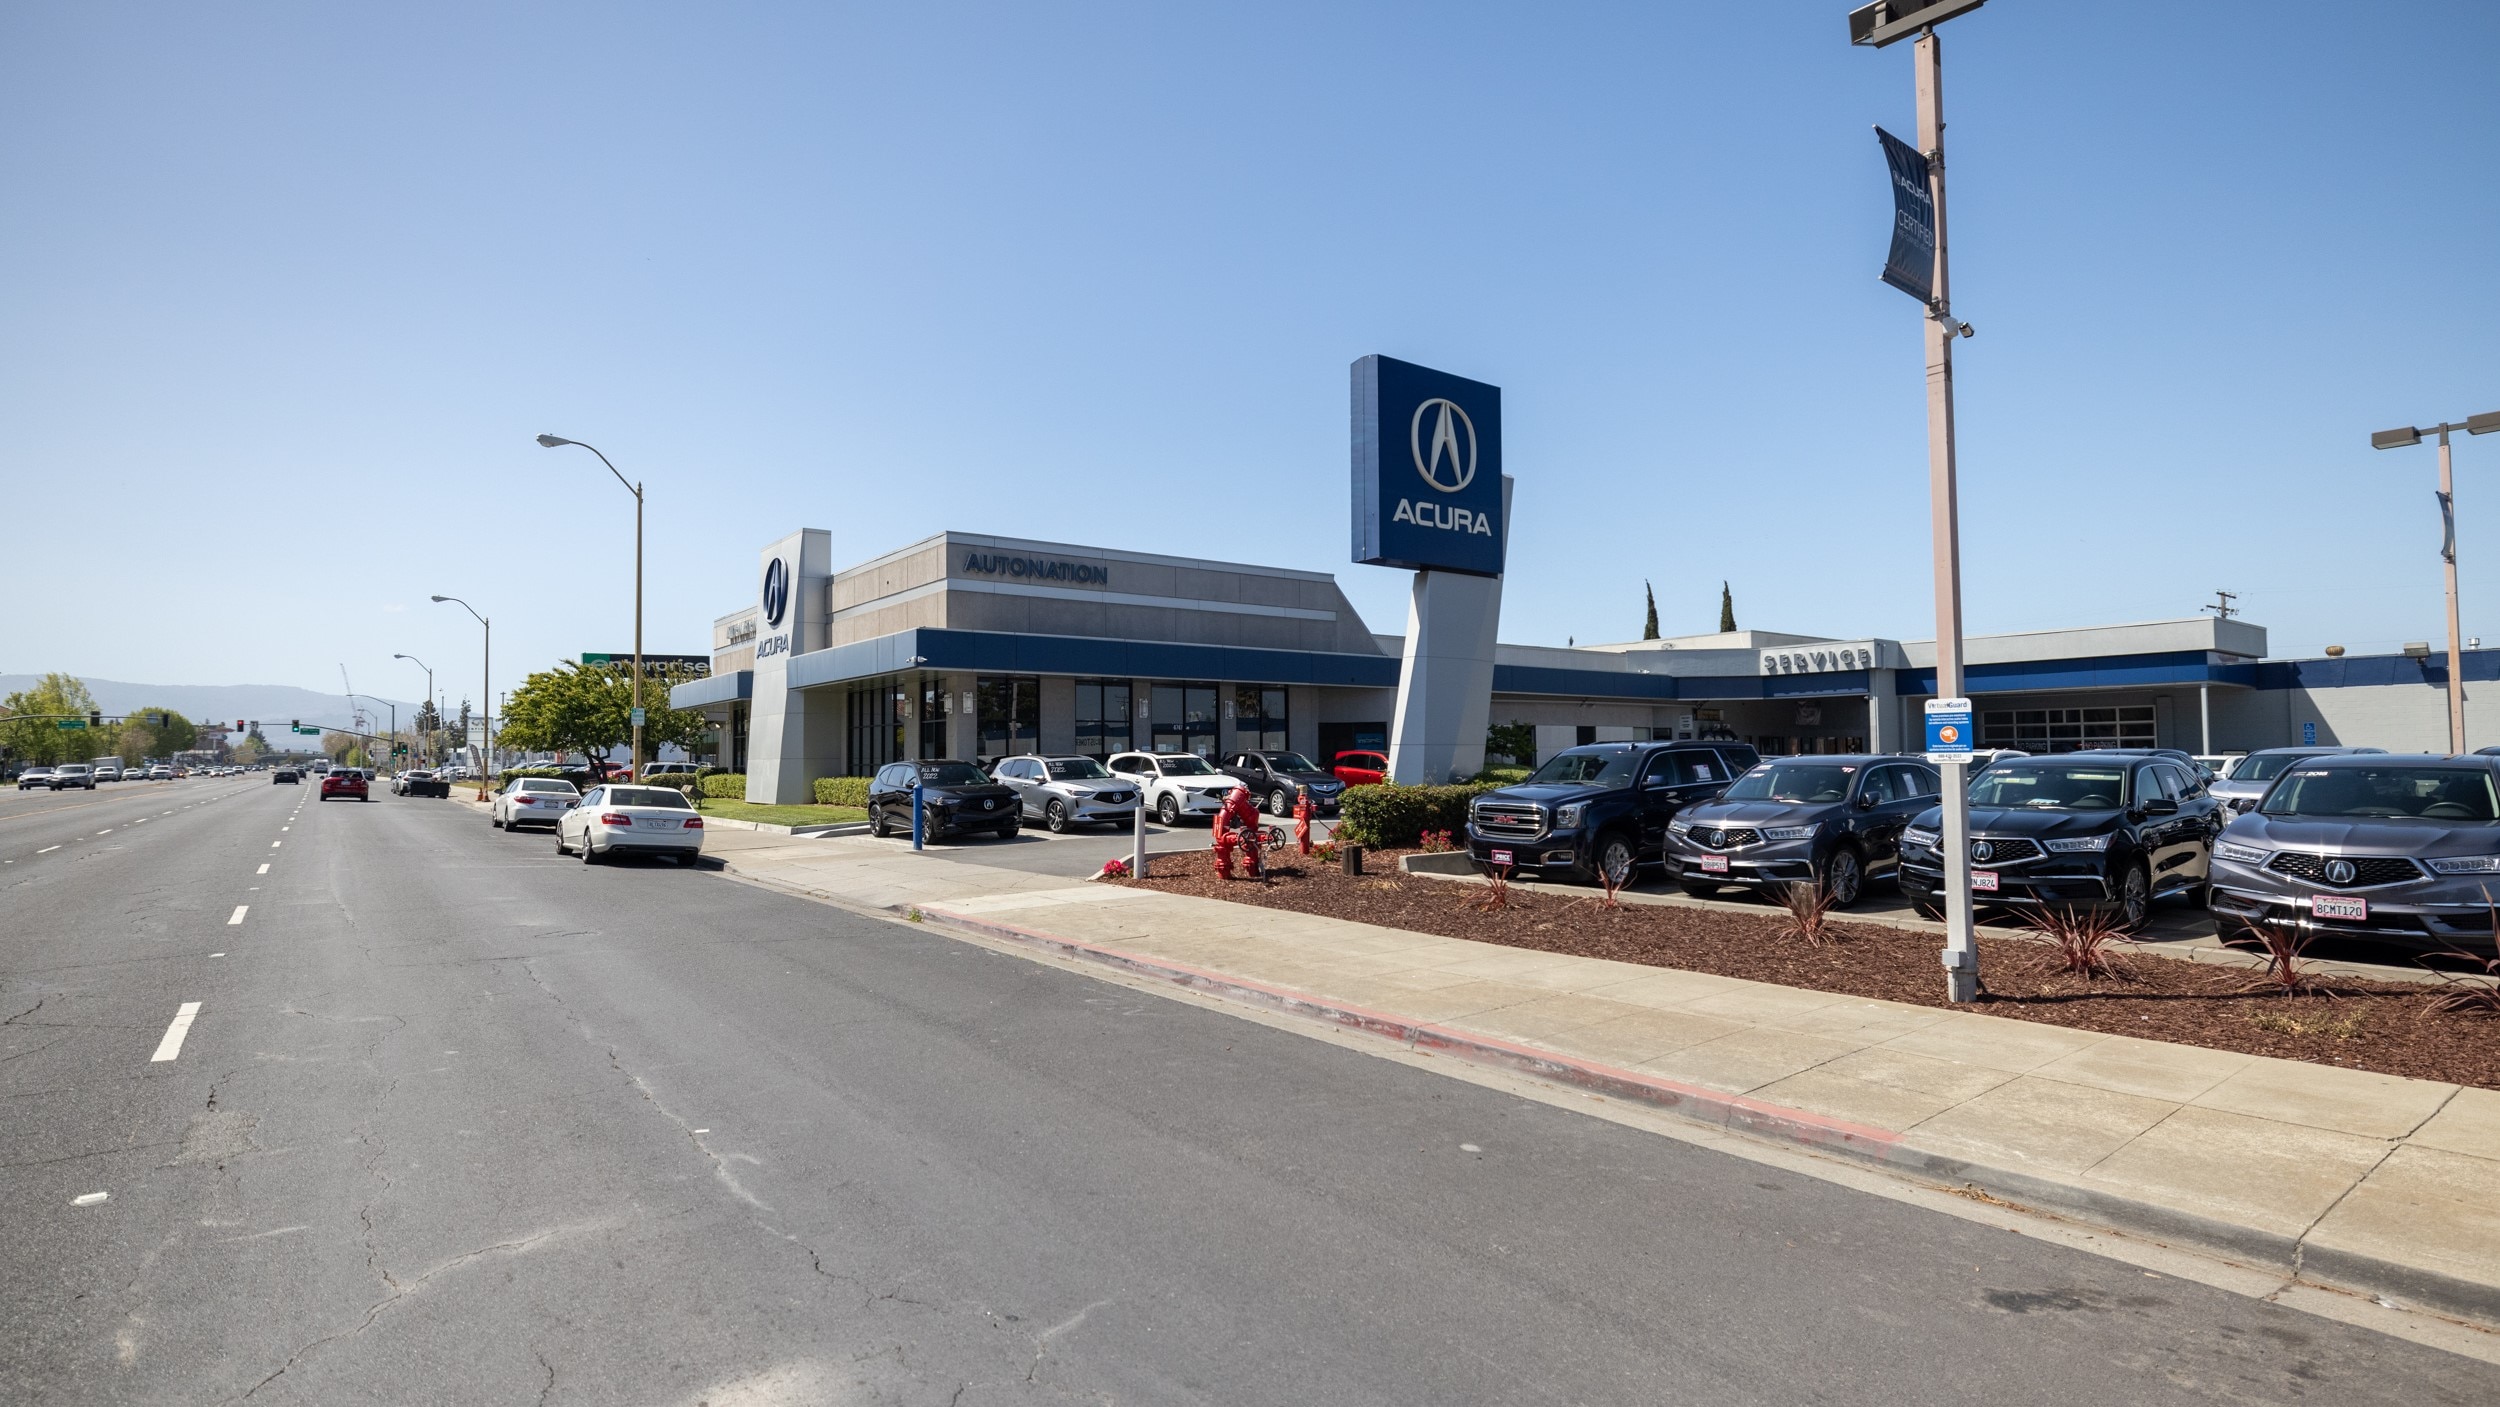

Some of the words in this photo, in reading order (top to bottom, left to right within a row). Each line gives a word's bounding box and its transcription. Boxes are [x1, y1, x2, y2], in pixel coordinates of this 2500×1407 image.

[1901, 176, 1932, 206] ACURA
[1898, 209, 1934, 247] CERTIFIED
[1392, 498, 1492, 537] ACURA
[964, 553, 1108, 584] AUTONATION
[756, 633, 789, 659] ACURA
[1764, 648, 1870, 669] SERVICE
[1493, 815, 1519, 825] GMC
